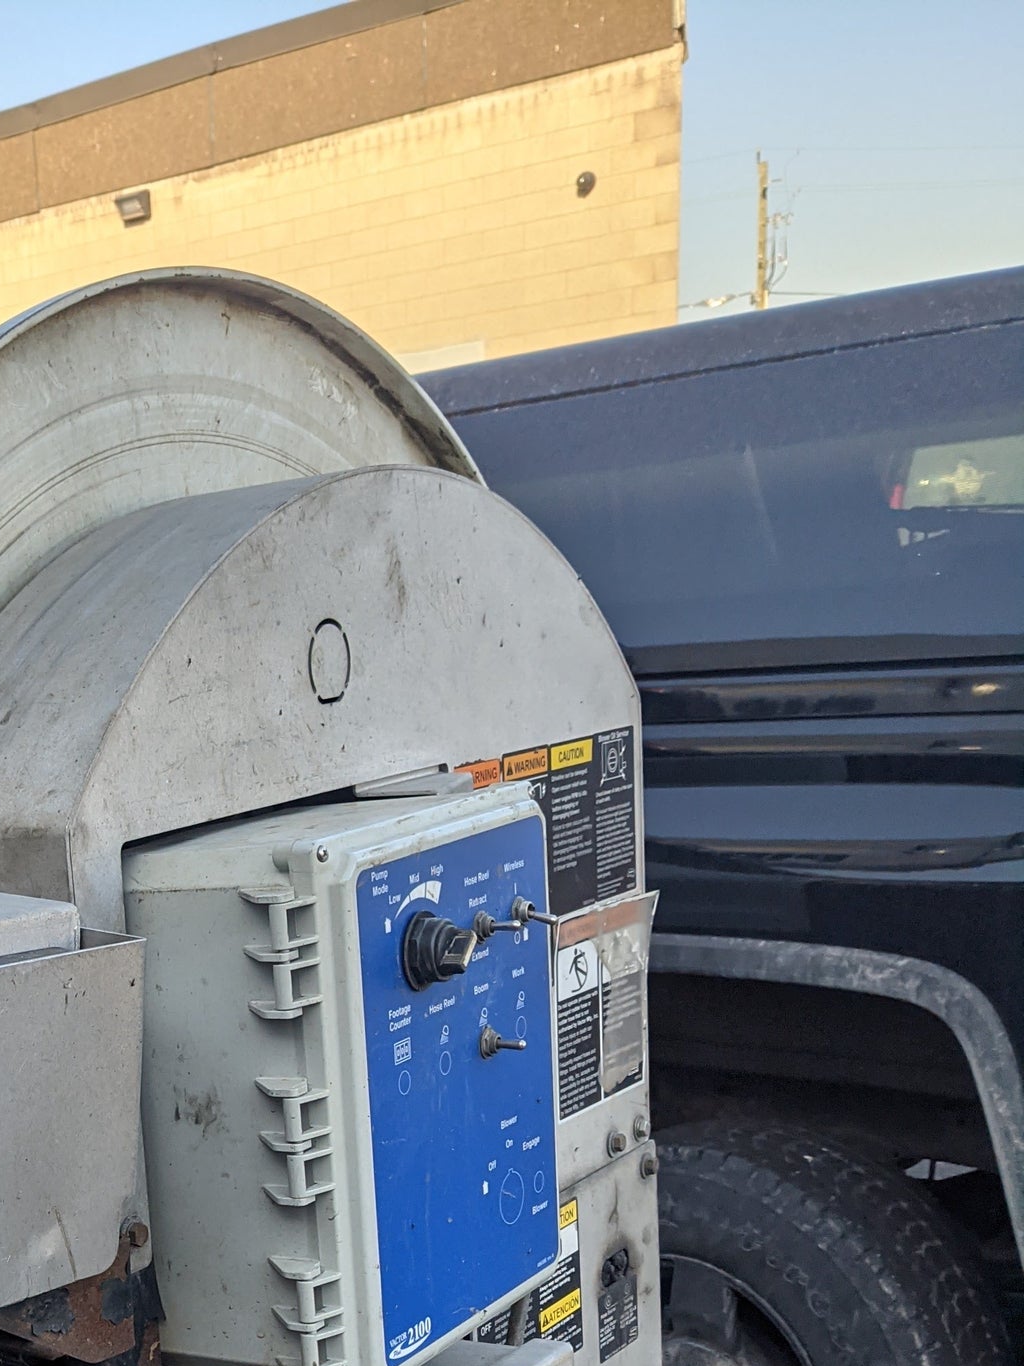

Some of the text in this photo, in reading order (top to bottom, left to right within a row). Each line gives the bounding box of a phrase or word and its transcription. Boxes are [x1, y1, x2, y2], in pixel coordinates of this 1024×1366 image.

[558, 747, 584, 763] CAUTION
[514, 756, 545, 773] WARNING
[431, 864, 443, 876] High
[504, 860, 524, 872] Wireless
[371, 870, 388, 882] Pump
[410, 873, 420, 884] Mid
[464, 871, 489, 887] Hose Reel
[373, 884, 389, 896] Mode
[389, 895, 401, 904] Low
[469, 895, 487, 908] Retract
[472, 948, 489, 962] Extend
[512, 967, 525, 979] Work
[474, 983, 488, 995] Boom
[389, 1005, 411, 1019] Footage
[429, 996, 455, 1014] Hose Reel
[389, 1017, 411, 1032] Counter
[500, 1115, 517, 1130] Blower
[506, 1139, 513, 1149] On
[522, 1136, 540, 1151] Engage
[532, 1200, 548, 1215] Blower
[408, 1317, 431, 1345] 2100
